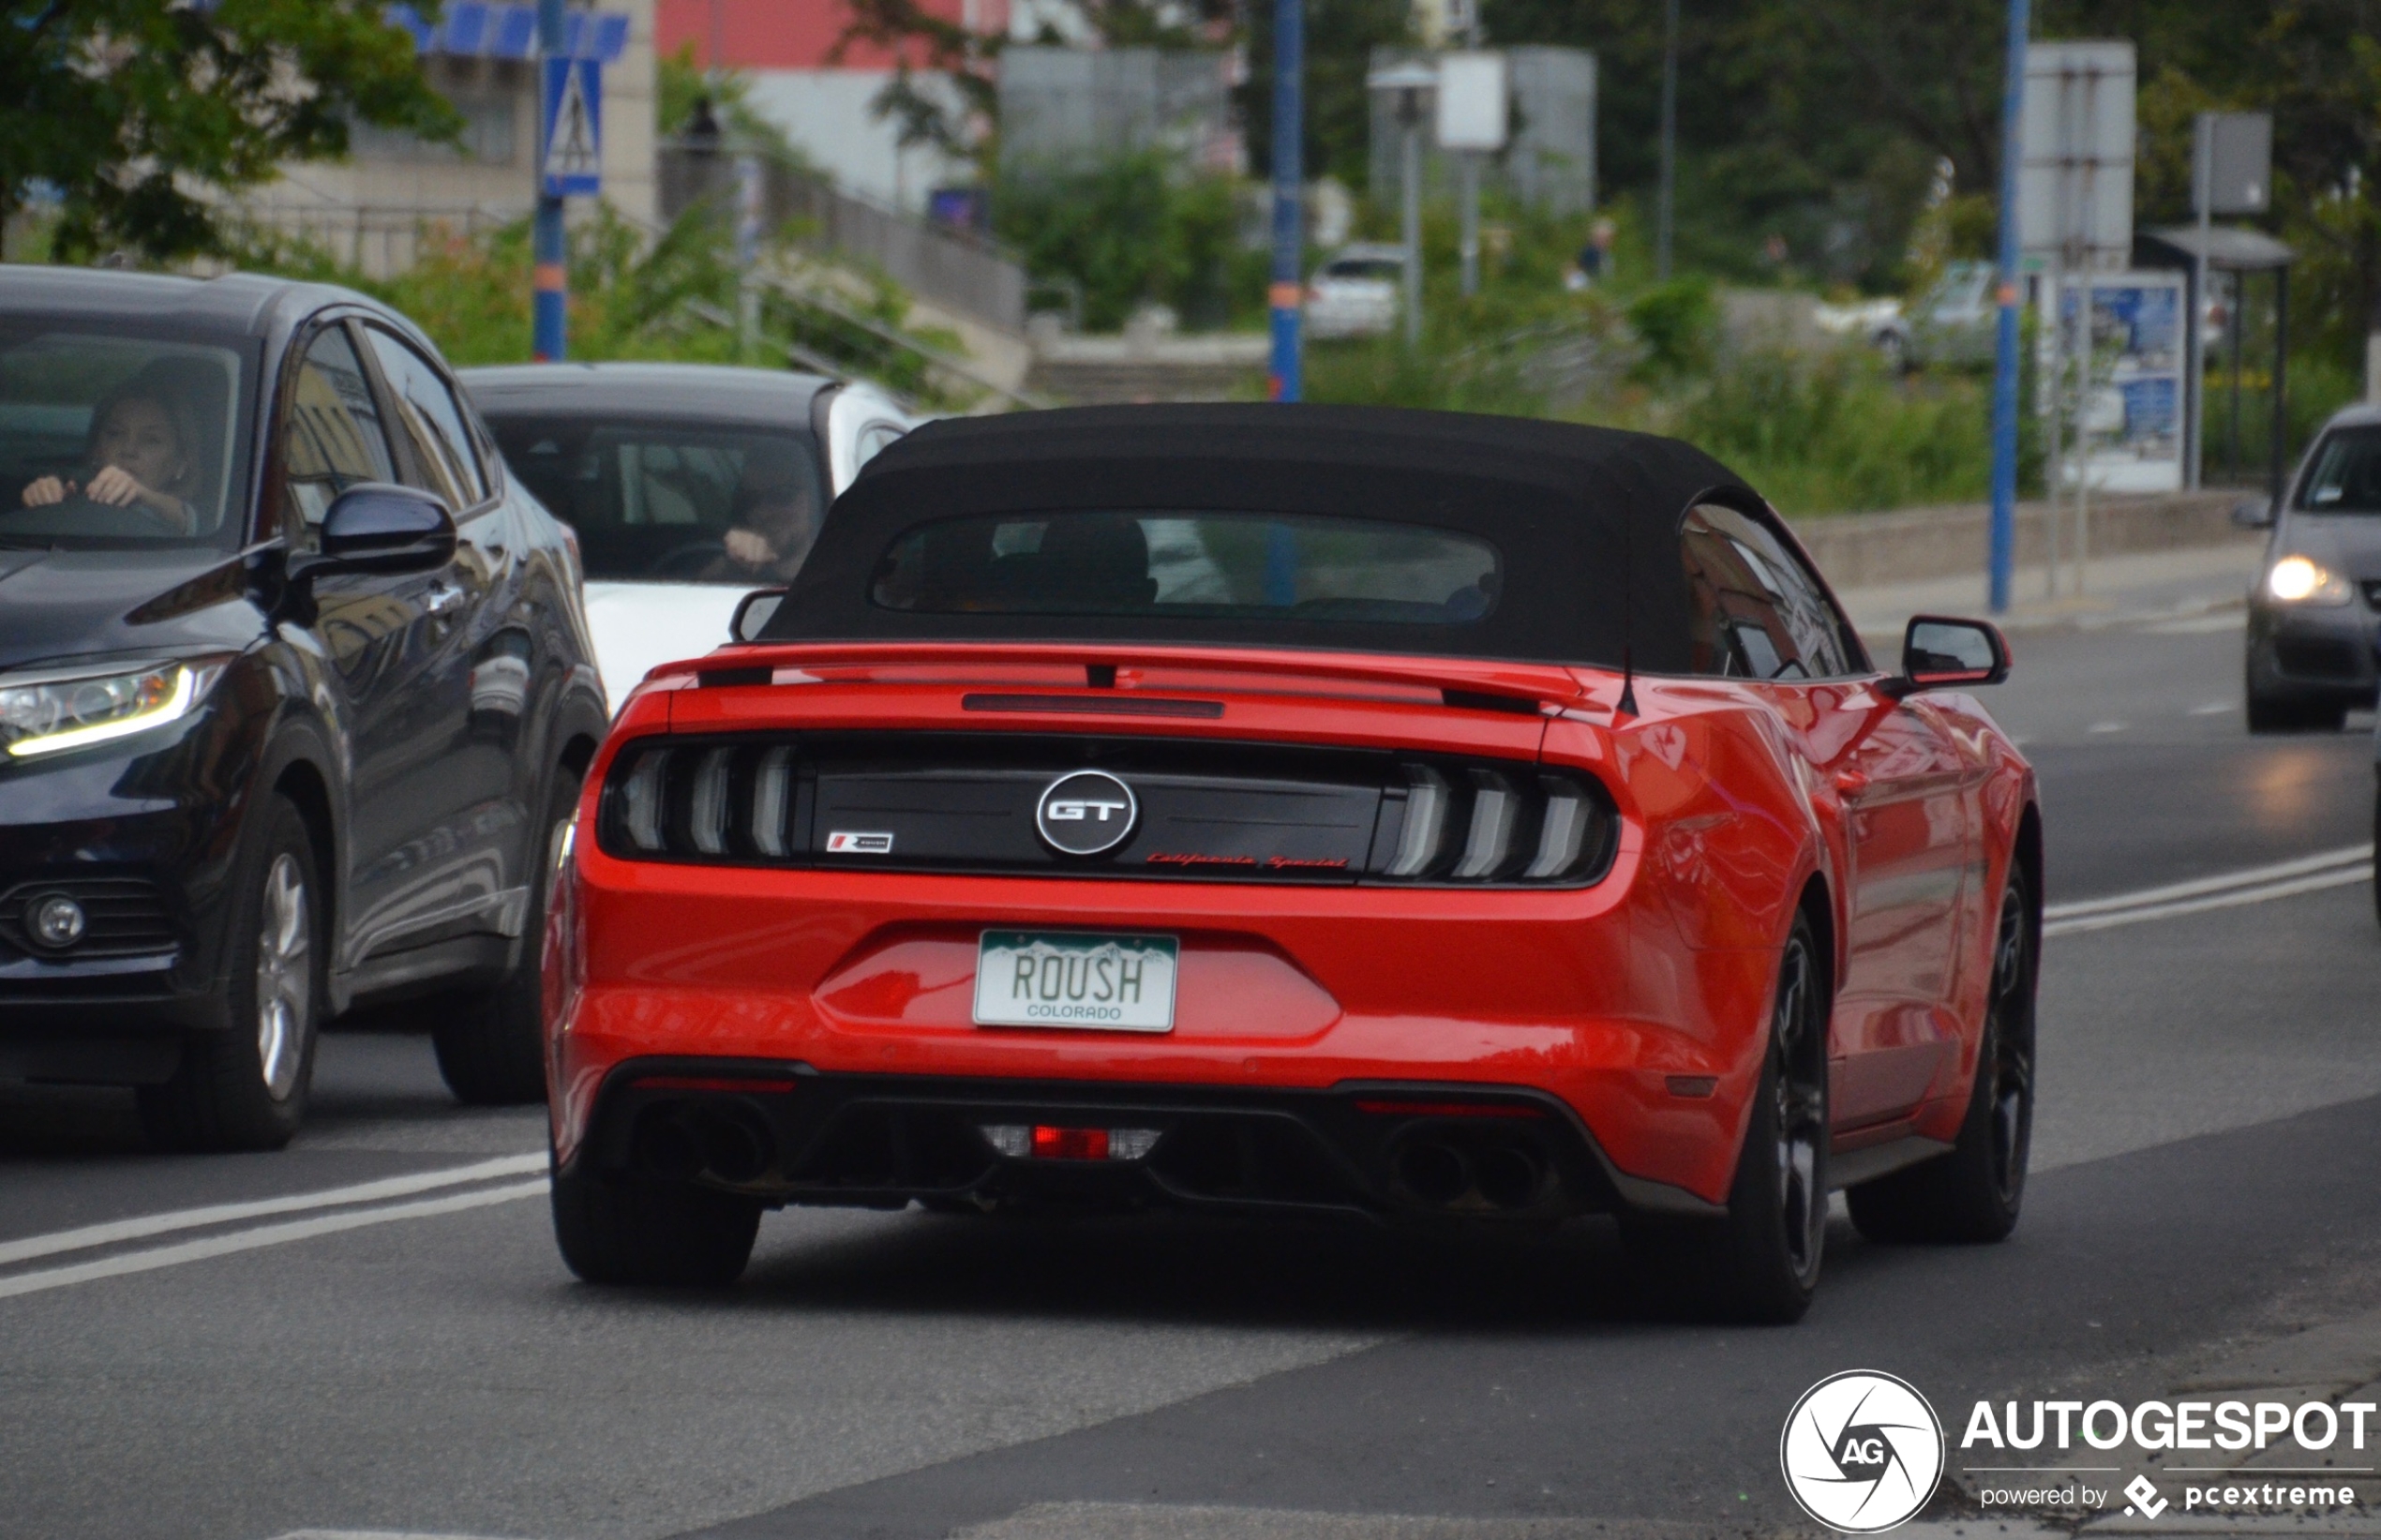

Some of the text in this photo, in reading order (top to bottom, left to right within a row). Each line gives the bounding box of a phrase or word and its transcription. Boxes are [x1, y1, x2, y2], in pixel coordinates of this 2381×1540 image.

[1048, 800, 1125, 821] GT
[1012, 955, 1143, 1004] ROUSH
[1027, 1005, 1121, 1020] COLORADO
